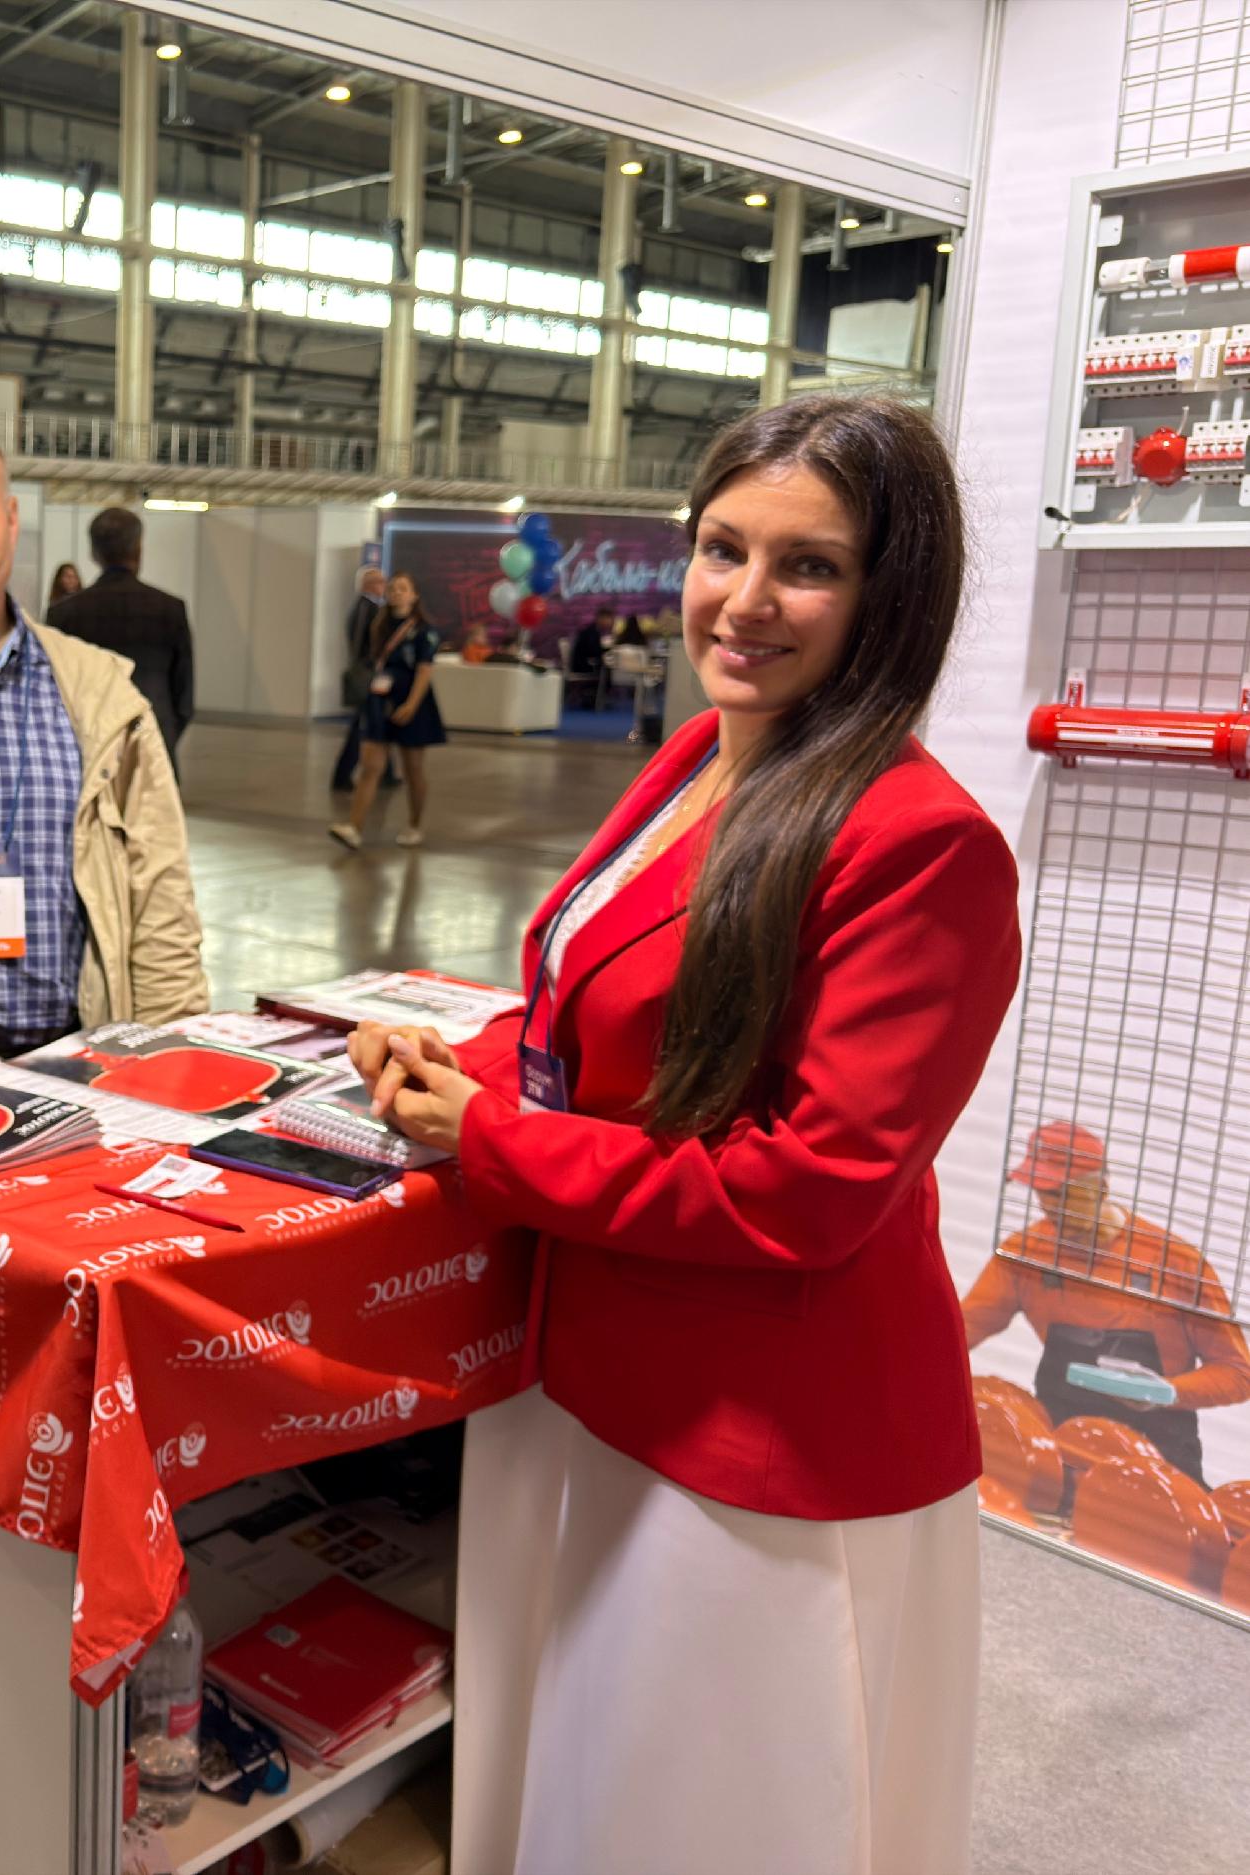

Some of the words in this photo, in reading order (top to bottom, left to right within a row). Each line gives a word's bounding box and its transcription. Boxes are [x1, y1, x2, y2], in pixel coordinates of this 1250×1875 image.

[63, 1238, 175, 1328] ЭПОТОС
[367, 1252, 467, 1306] ЭПОТОС
[176, 1314, 289, 1362] ЭПОТОС
[268, 1387, 399, 1432] ЭПОТОС
